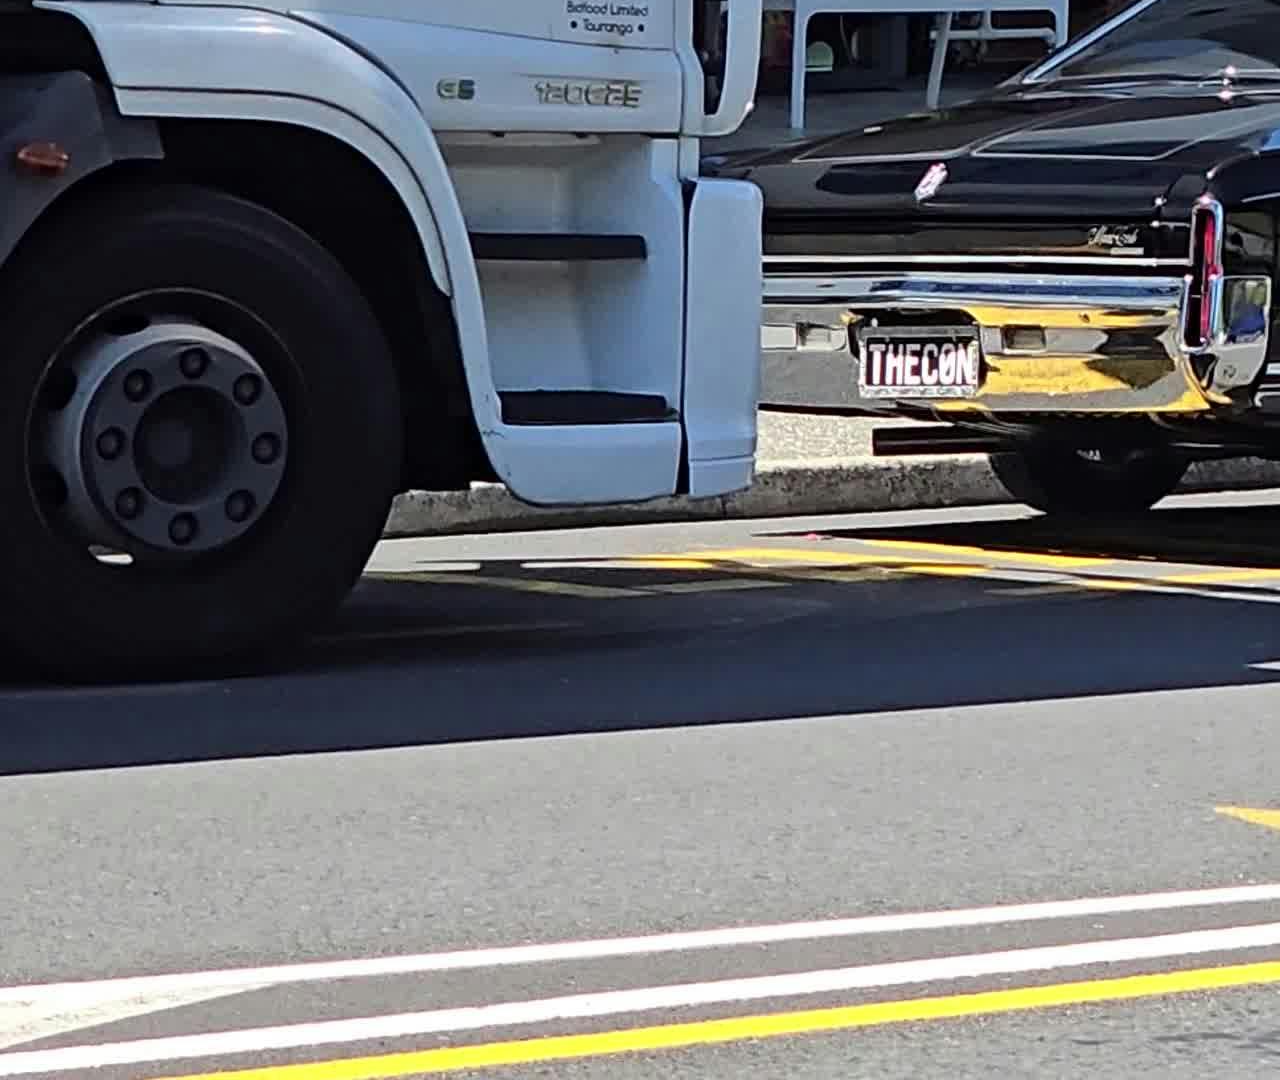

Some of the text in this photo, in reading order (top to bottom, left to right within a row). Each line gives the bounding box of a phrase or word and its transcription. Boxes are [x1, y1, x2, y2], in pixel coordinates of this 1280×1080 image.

[567, 0, 648, 17] Bidfood Limited
[583, 19, 633, 36] Tauranga
